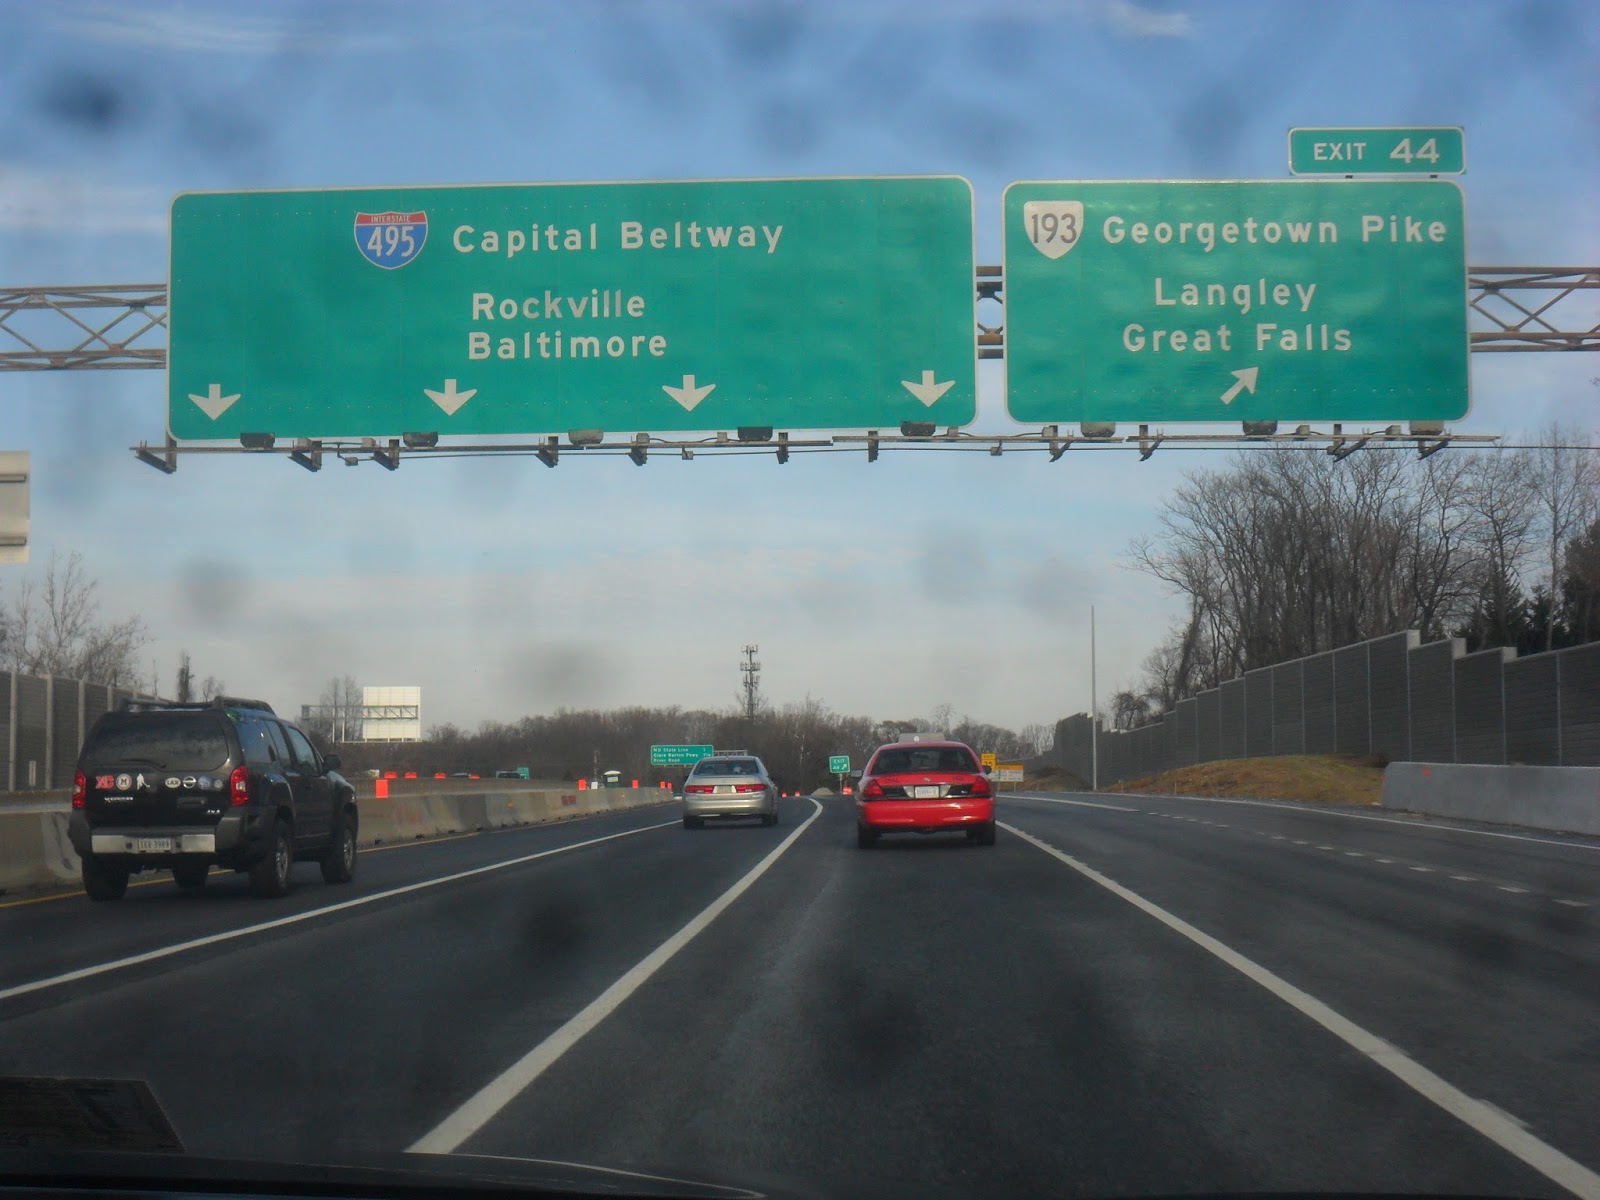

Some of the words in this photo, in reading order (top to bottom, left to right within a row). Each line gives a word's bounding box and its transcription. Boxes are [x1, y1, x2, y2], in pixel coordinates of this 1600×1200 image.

[1313, 142, 1367, 161] EXIT
[1390, 138, 1440, 164] 44
[371, 214, 411, 223] INTERSTATE
[1031, 212, 1077, 244] 193
[1103, 215, 1338, 252] Georgetown
[1362, 214, 1448, 243] Pike
[367, 225, 415, 258] 495
[452, 222, 597, 259] Capital
[620, 221, 783, 254] Beltway
[472, 288, 646, 321] Rockville
[1155, 277, 1317, 315] Langley
[468, 330, 668, 360] Baltimore
[1123, 323, 1232, 352] Great
[1256, 323, 1353, 352] Falls
